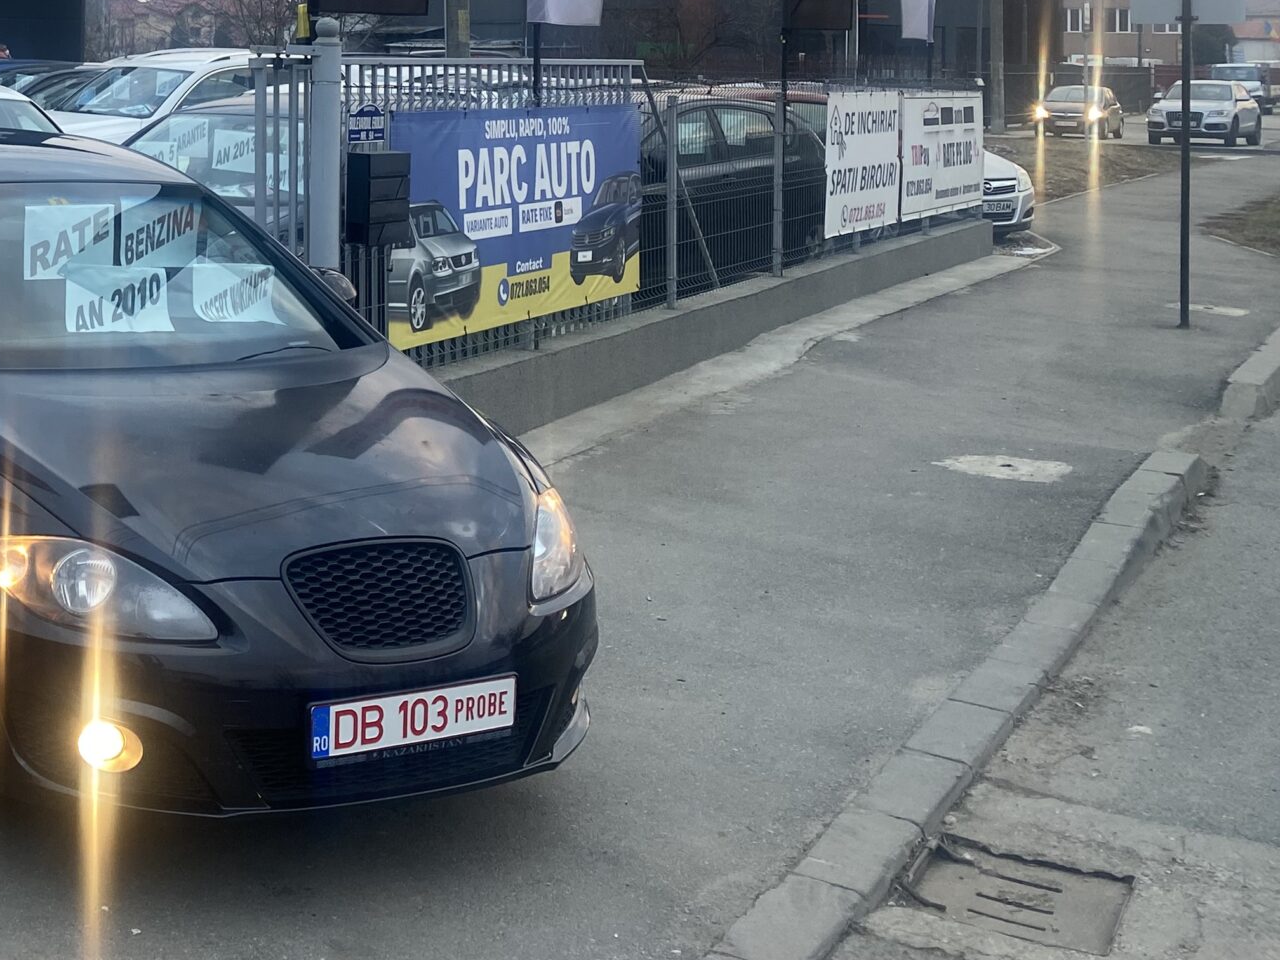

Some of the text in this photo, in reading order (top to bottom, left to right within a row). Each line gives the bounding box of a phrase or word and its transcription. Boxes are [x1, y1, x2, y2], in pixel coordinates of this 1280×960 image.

[484, 117, 570, 141] SIMPLU, RAPID, 100%
[844, 112, 856, 136] DE
[857, 109, 897, 135] INCHIRIAT
[215, 132, 256, 168] AN 2013
[458, 139, 596, 210] PARC AUTO
[829, 162, 898, 197] SPATII BIROURI
[521, 208, 538, 225] RATE
[539, 206, 552, 222] FIXE
[996, 201, 1012, 211] BAM
[124, 203, 195, 266] BENZINA
[466, 215, 509, 234] VARIANTE AUTO
[29, 207, 109, 278] RATE
[516, 257, 544, 274] Contact
[75, 273, 161, 332] AN 2010
[510, 275, 550, 300] 0721.863.054
[313, 690, 508, 753] RO DB 103 PROBE
